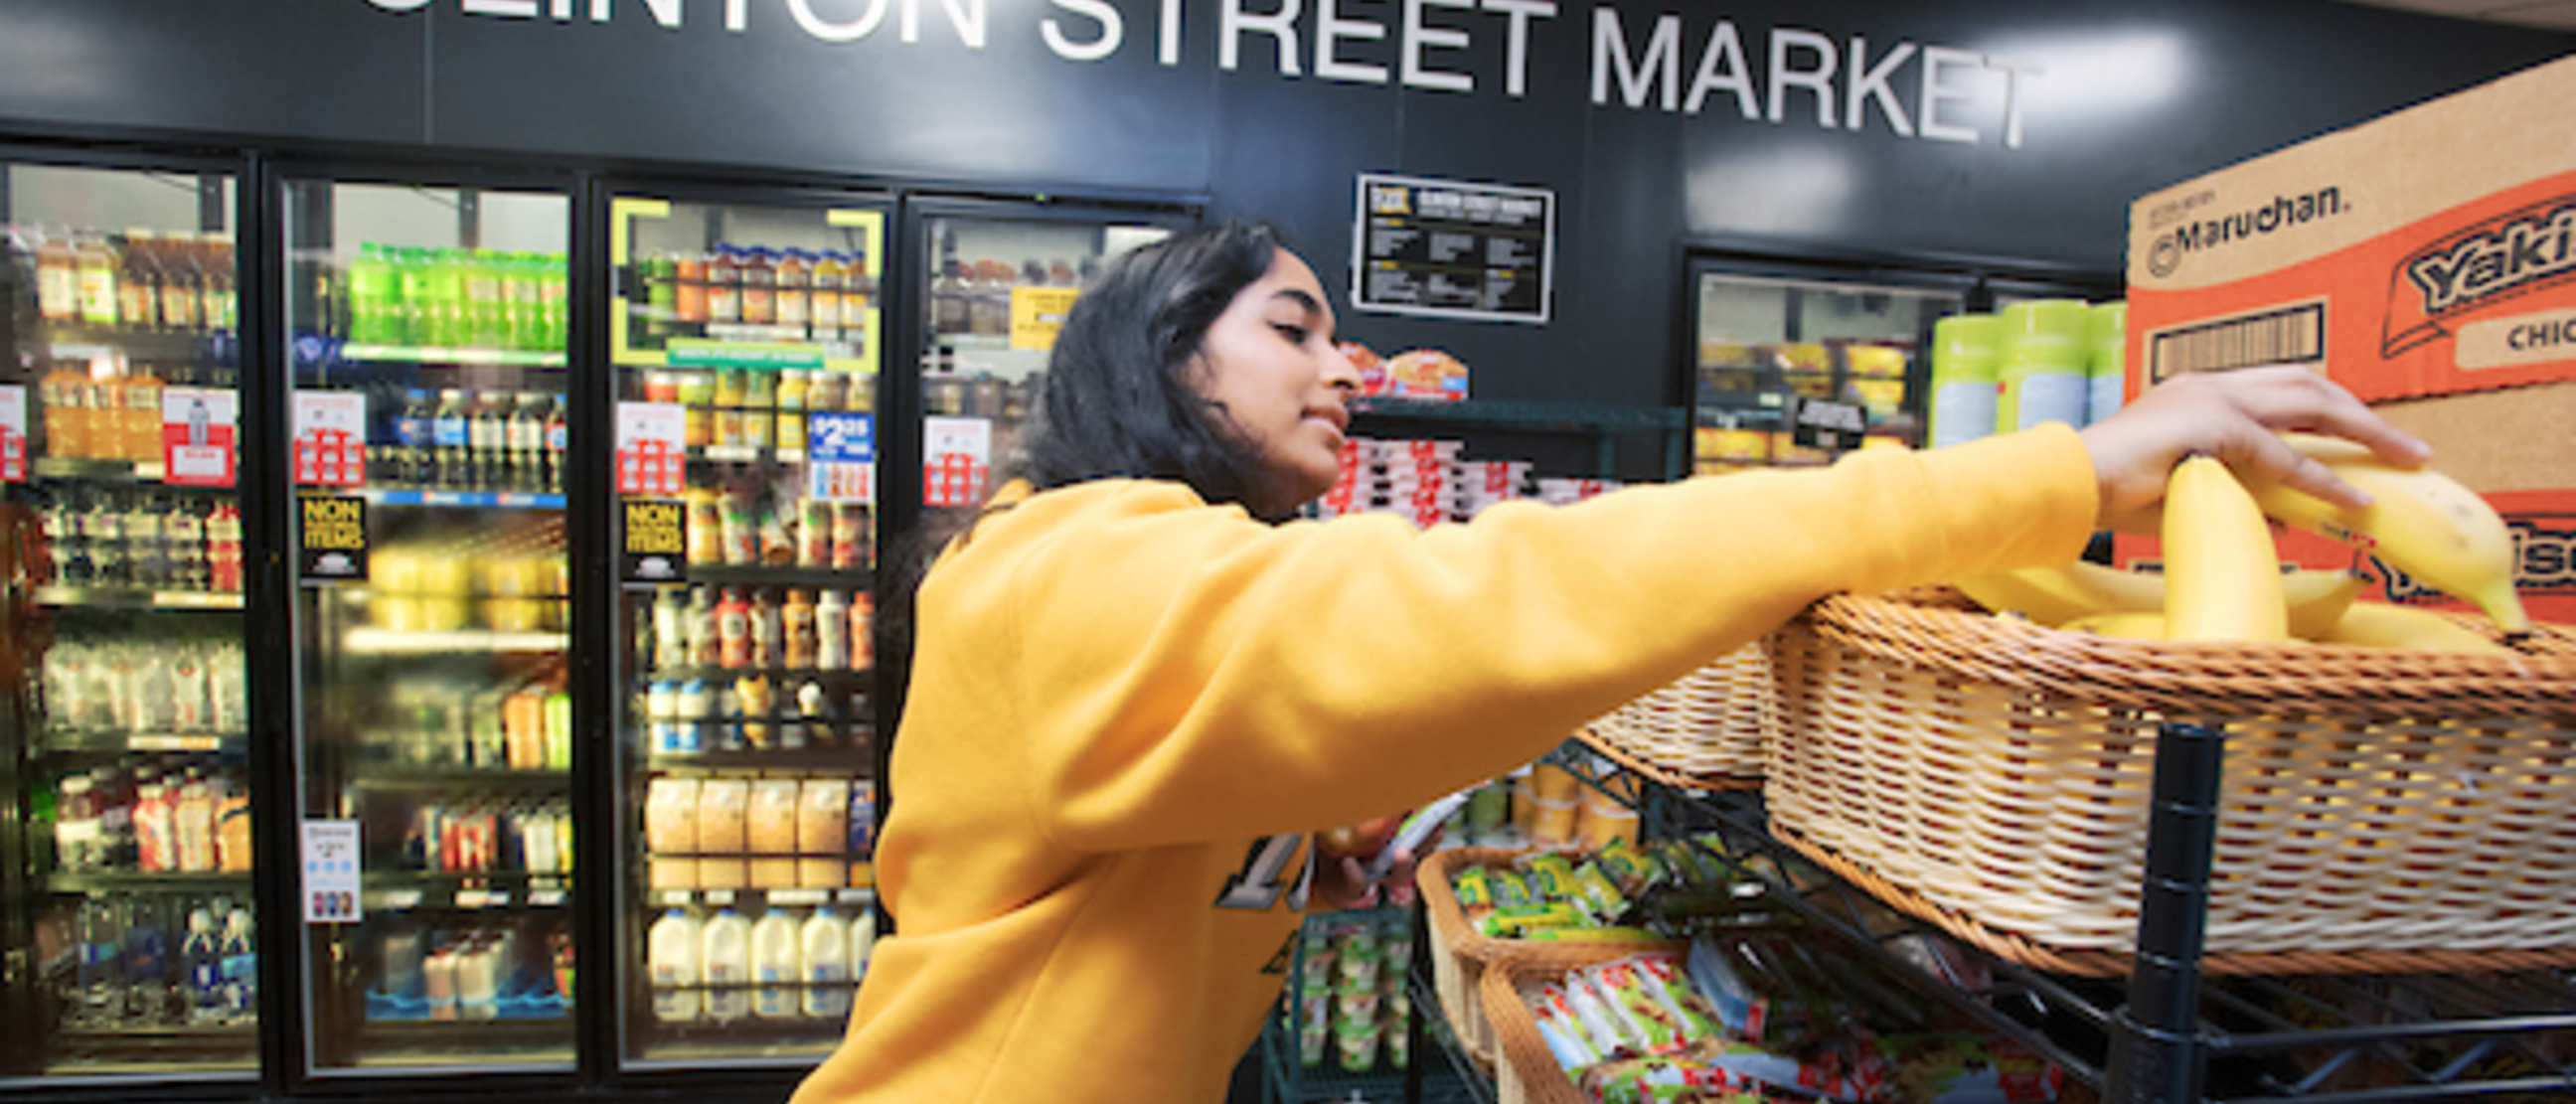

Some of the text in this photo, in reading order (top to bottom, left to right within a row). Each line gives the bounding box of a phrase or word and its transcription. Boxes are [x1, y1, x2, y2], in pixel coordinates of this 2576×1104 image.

[1041, 0, 1557, 96] STREET
[1591, 8, 2046, 149] MARKET
[304, 499, 361, 522] NON
[626, 504, 679, 526] NON
[304, 529, 365, 550] ITEMS
[626, 533, 684, 553] ITEMS
